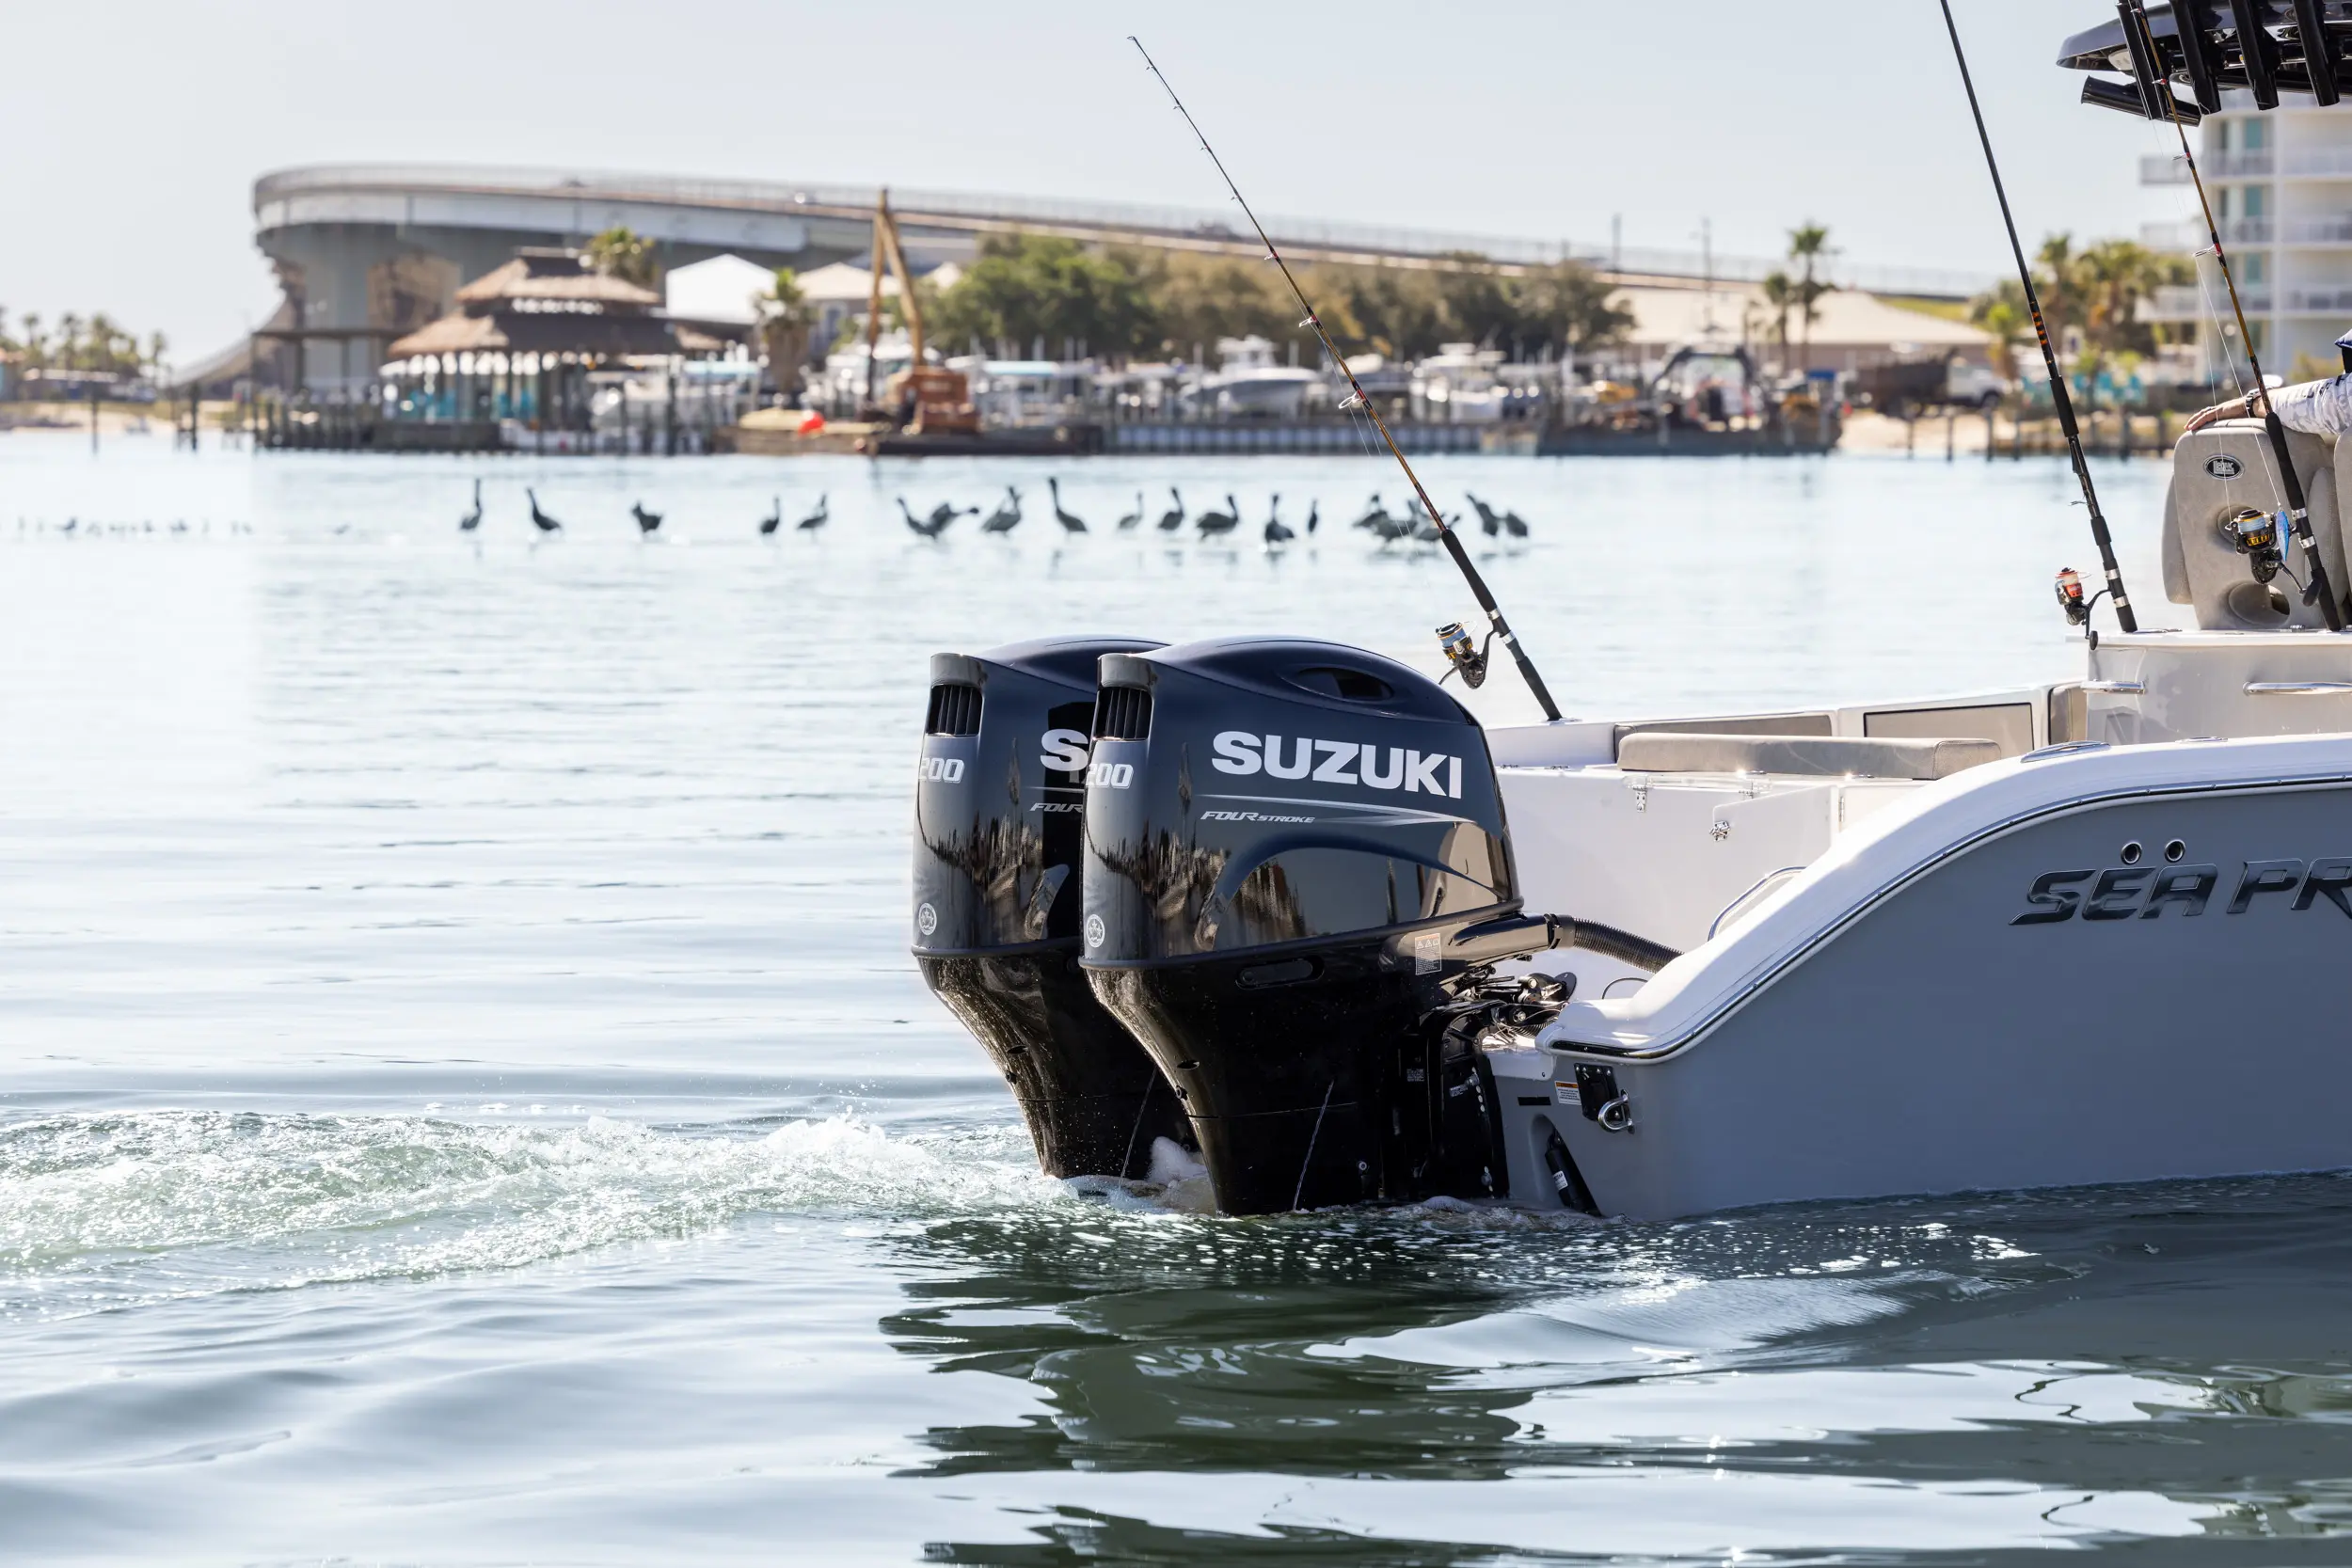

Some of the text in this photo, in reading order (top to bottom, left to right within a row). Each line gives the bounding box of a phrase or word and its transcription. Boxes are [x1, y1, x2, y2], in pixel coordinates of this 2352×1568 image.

[1086, 763, 1134, 789] 200
[1212, 731, 1462, 800] SUZUKI
[2009, 863, 2218, 926] SEA
